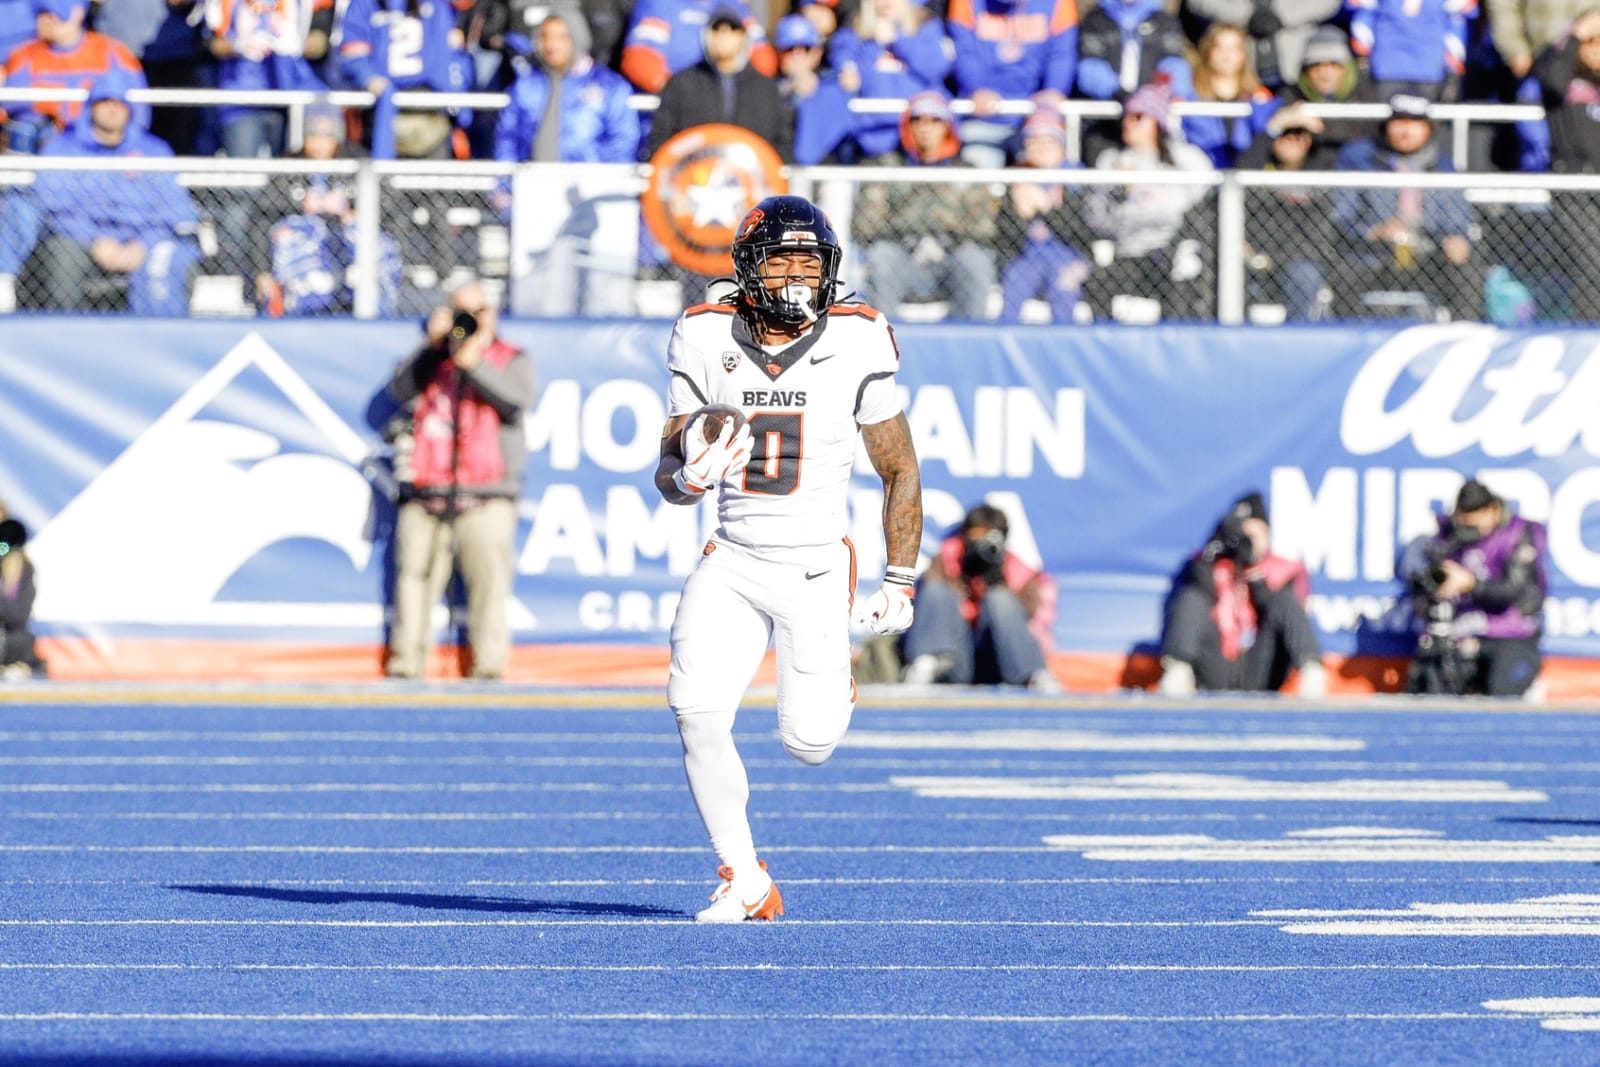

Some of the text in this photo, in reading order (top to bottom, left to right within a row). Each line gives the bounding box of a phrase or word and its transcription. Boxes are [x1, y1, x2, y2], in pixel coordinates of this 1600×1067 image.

[387, 16, 424, 77] 2
[524, 378, 1086, 479] MOAIN
[742, 390, 807, 407] BEAVS
[742, 411, 804, 496] 0
